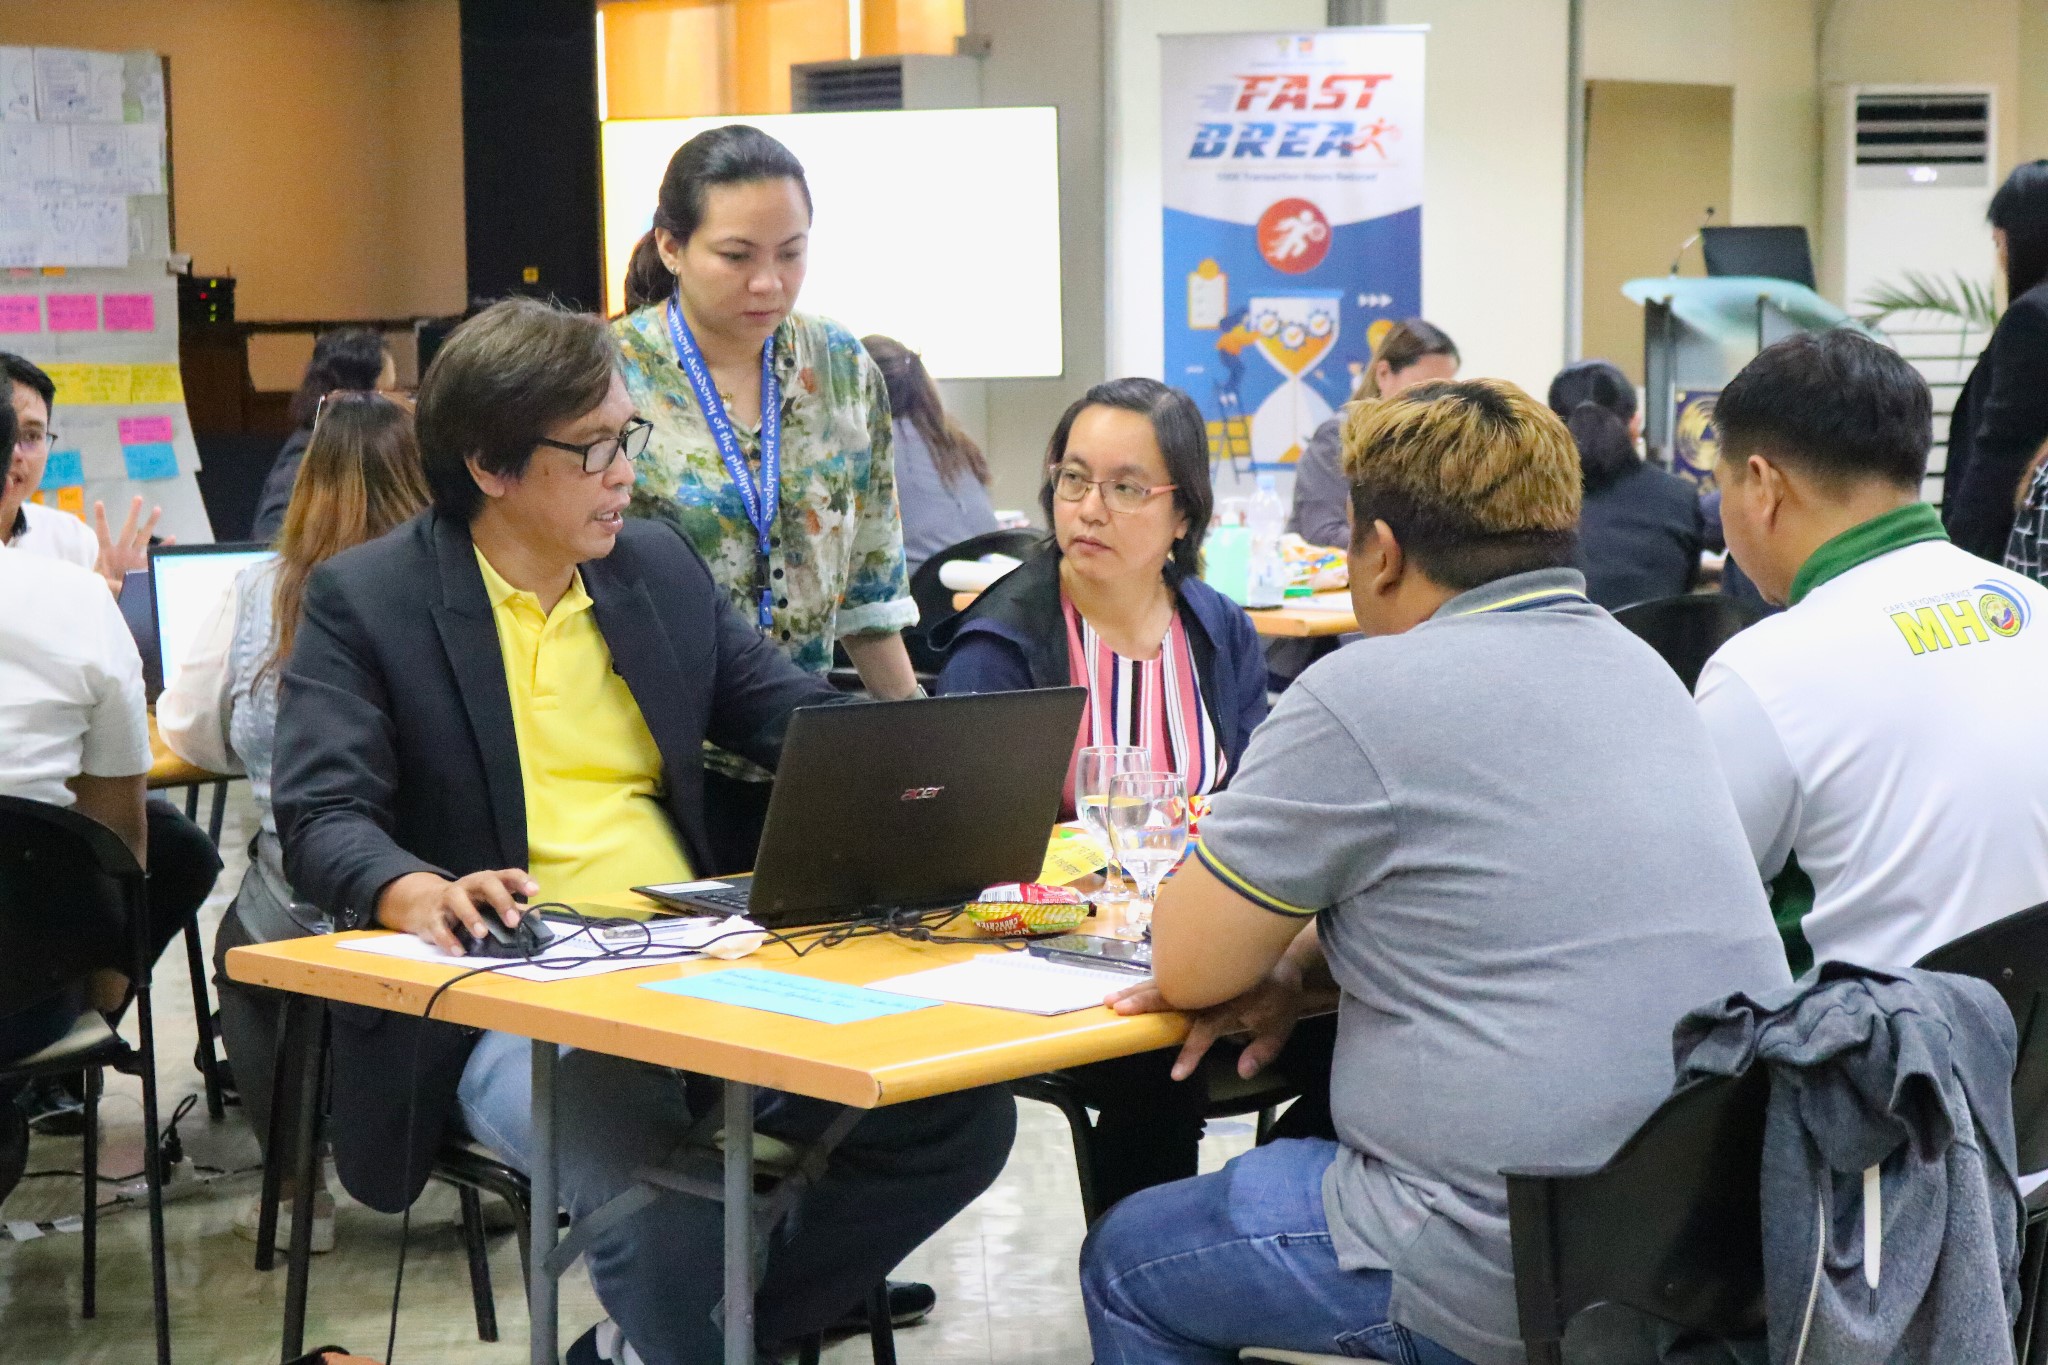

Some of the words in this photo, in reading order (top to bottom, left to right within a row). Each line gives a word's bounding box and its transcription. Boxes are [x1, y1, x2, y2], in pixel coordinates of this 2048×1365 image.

[1233, 73, 1393, 112] FAST
[687, 356, 718, 416] academy
[713, 417, 729, 430] of
[766, 378, 778, 438] academy
[719, 431, 733, 452] the
[726, 454, 760, 522] philippines
[763, 440, 777, 522] development
[1882, 602, 1907, 614] CARE
[1907, 595, 1941, 608] BEYOND
[1941, 589, 1973, 601] SERVICE
[900, 785, 945, 801] acer
